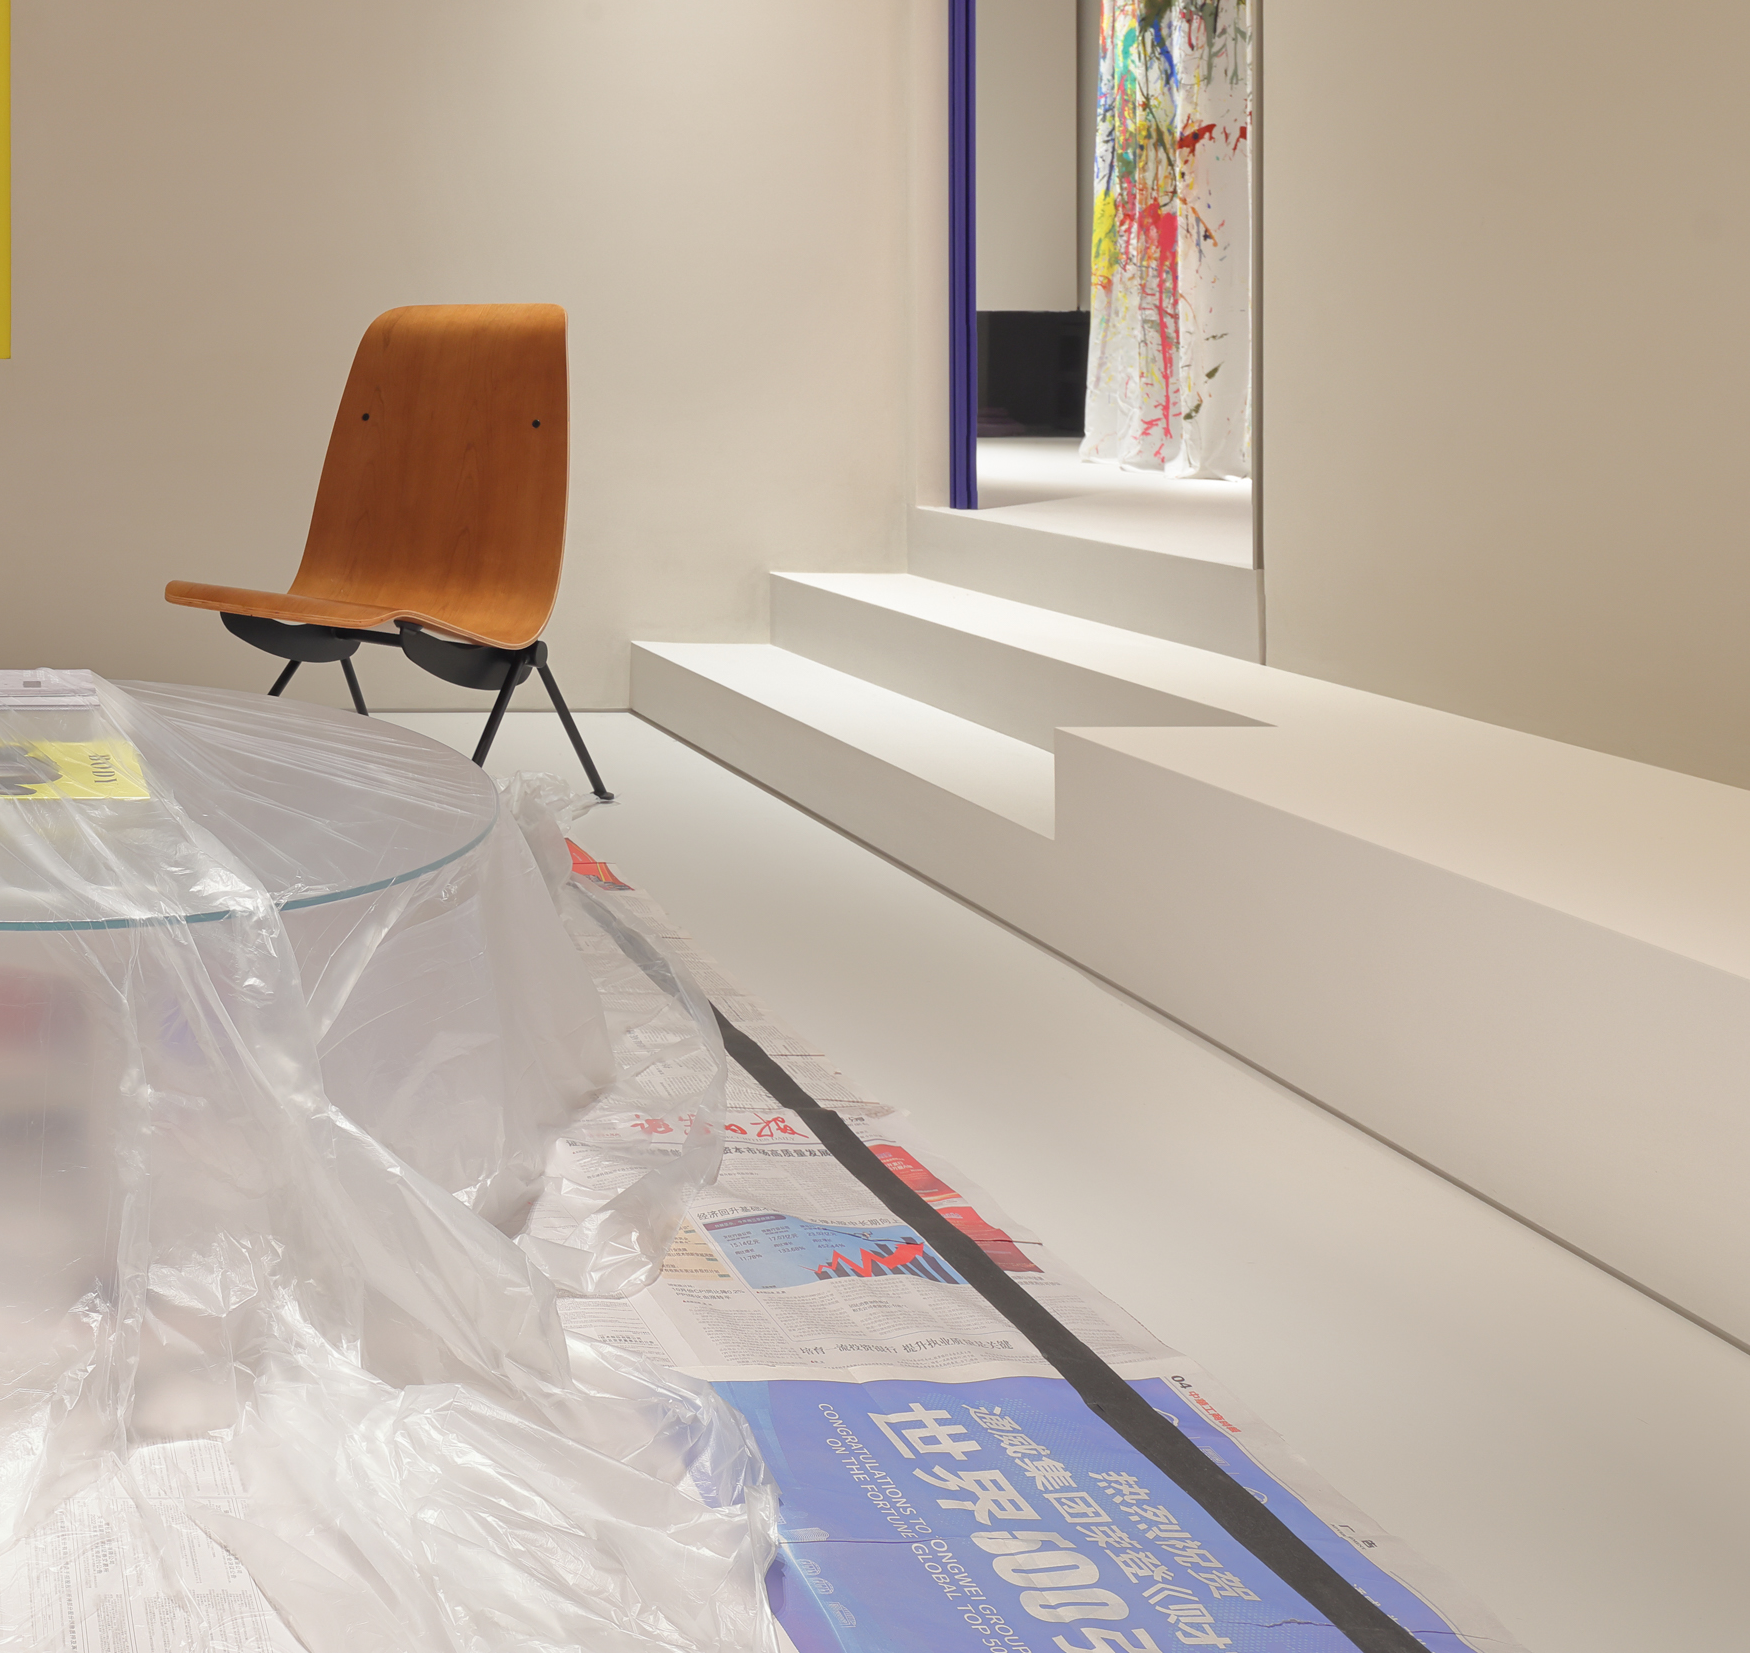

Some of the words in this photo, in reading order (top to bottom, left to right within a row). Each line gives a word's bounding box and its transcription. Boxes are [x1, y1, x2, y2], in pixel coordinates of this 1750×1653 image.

[86, 753, 119, 787] BODY
[1171, 1375, 1192, 1389] 04
[817, 1403, 918, 1517] CONGRATULATIONS
[913, 1516, 932, 1534] TO
[930, 1534, 987, 1600] ONGWEI
[826, 1437, 848, 1456] ON
[841, 1457, 871, 1482] THE
[861, 1483, 919, 1539] FORTUNE
[911, 1543, 962, 1601] GLOBAL
[957, 1603, 991, 1635] TOP
[1088, 1471, 1262, 1602] 热烈祝贺
